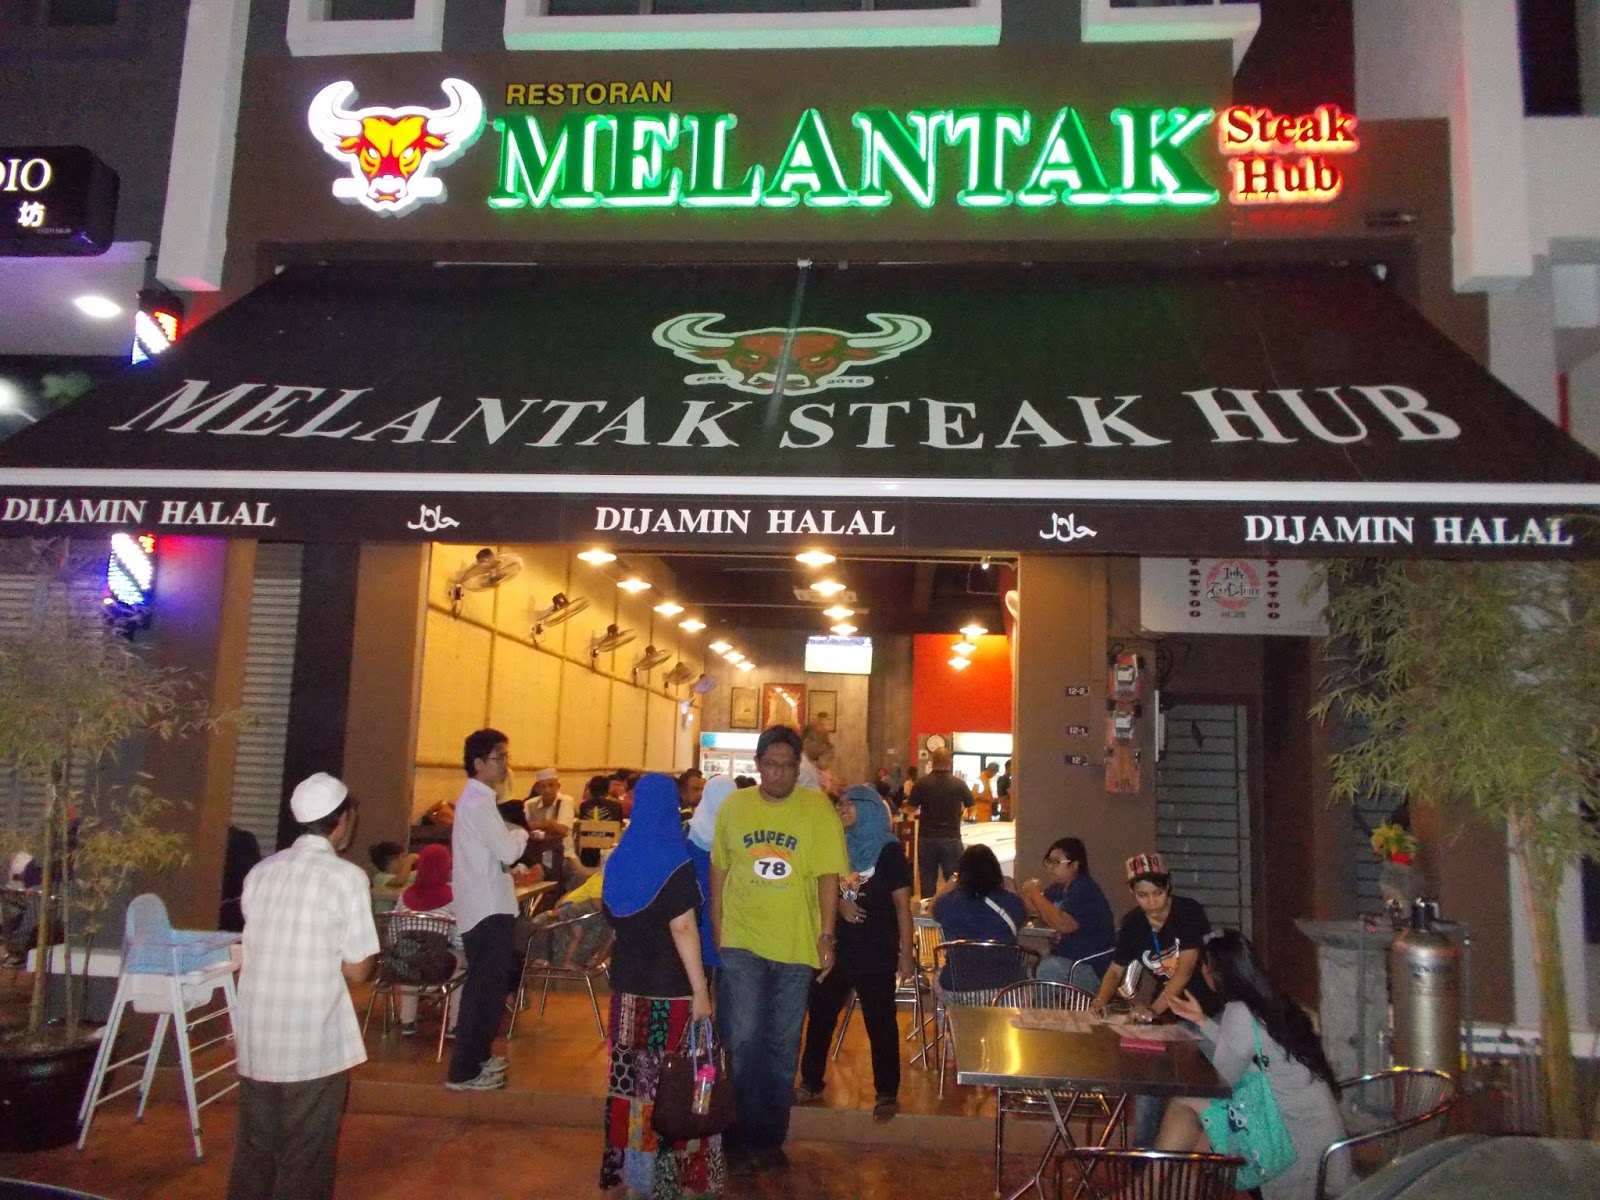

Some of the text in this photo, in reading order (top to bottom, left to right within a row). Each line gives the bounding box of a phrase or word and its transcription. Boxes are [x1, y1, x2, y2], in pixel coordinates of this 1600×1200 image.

[506, 81, 673, 106] RESTORAN
[1222, 103, 1358, 149] Steak
[488, 107, 1220, 208] MELANTAK
[1232, 154, 1344, 202] Hub
[17, 201, 46, 227] 坊
[826, 378, 866, 386] 2015
[108, 379, 1461, 450] MELANTAK STEAK HUB
[1, 498, 276, 527] DIJAMIN HALAL
[407, 504, 460, 532] حلال
[595, 506, 895, 536] DIJAMIN HALAL
[1039, 512, 1098, 542] حلال
[1243, 515, 1574, 546] DIJAMIN HALAL
[743, 830, 798, 851] SUPER
[758, 861, 786, 876] 78
